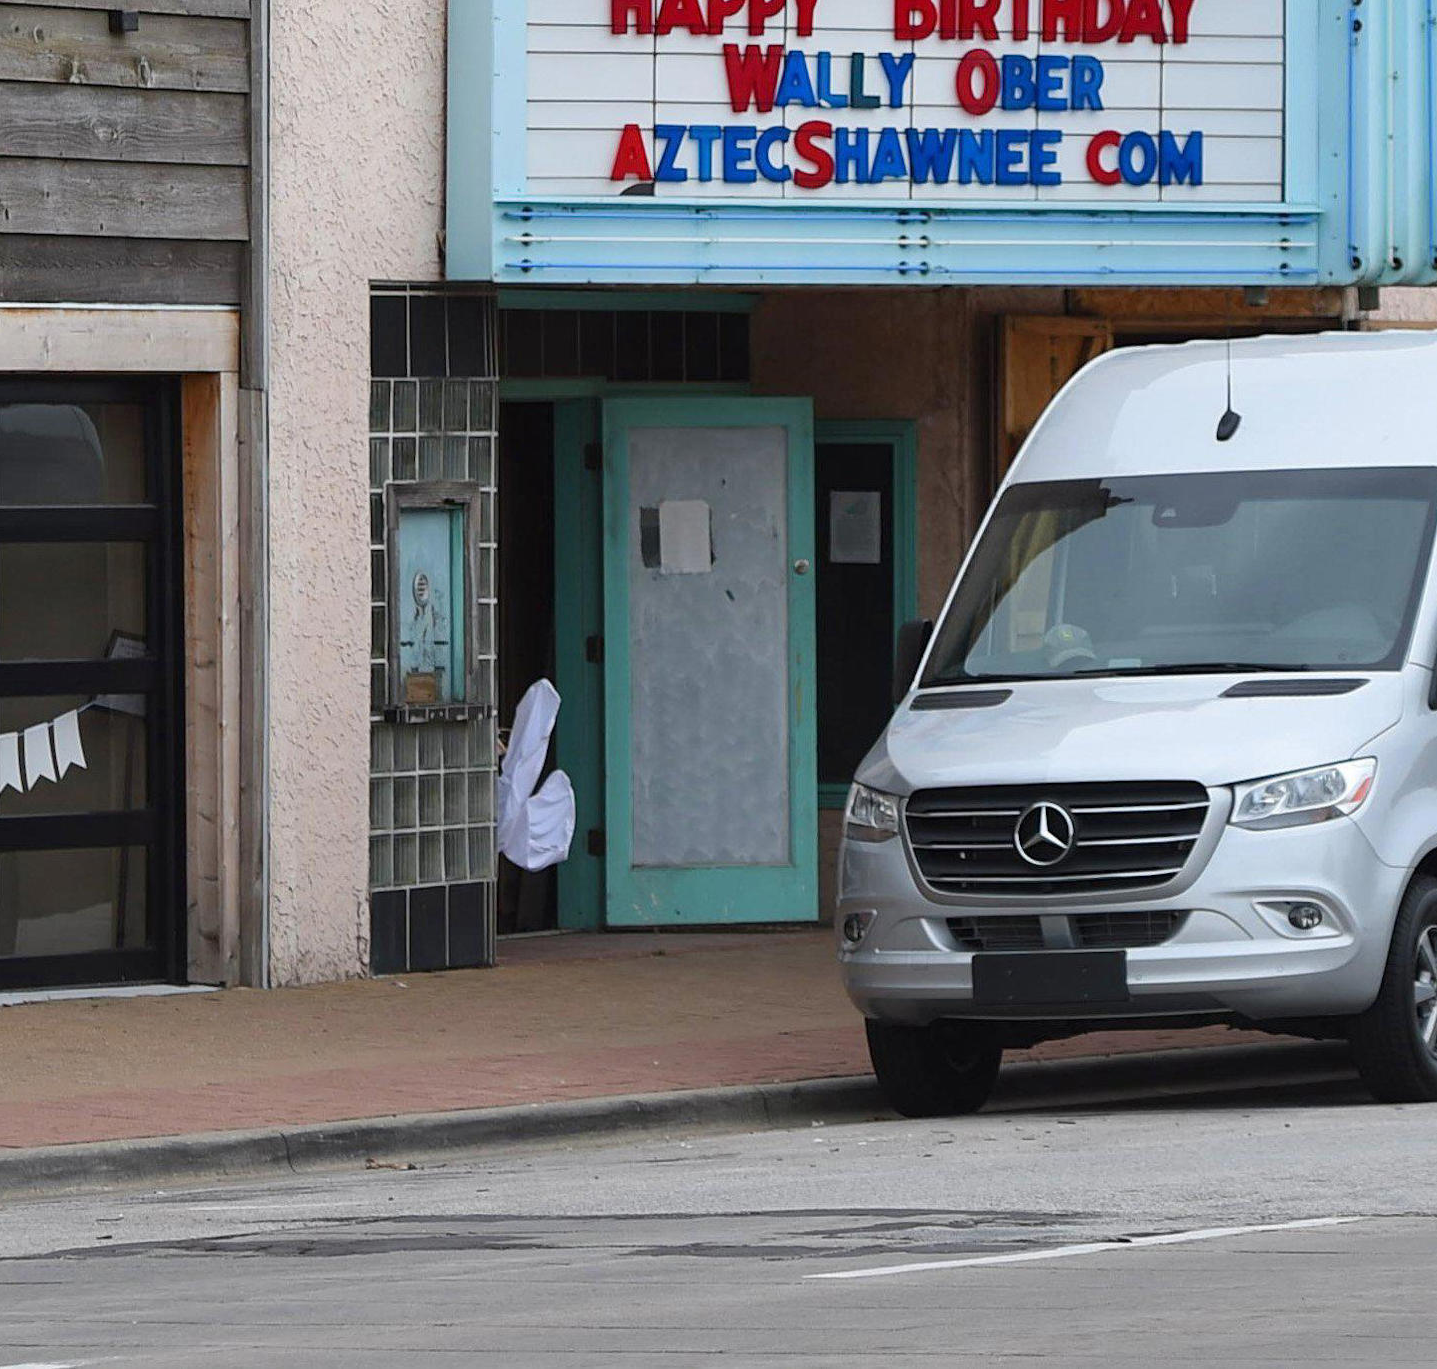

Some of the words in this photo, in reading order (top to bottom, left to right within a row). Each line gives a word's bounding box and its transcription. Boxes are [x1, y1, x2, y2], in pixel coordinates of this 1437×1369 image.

[723, 43, 916, 113] WALLY
[956, 48, 1105, 116] OBER
[611, 120, 1062, 189] AZTECSHAWNEE
[1086, 129, 1203, 187] COM
